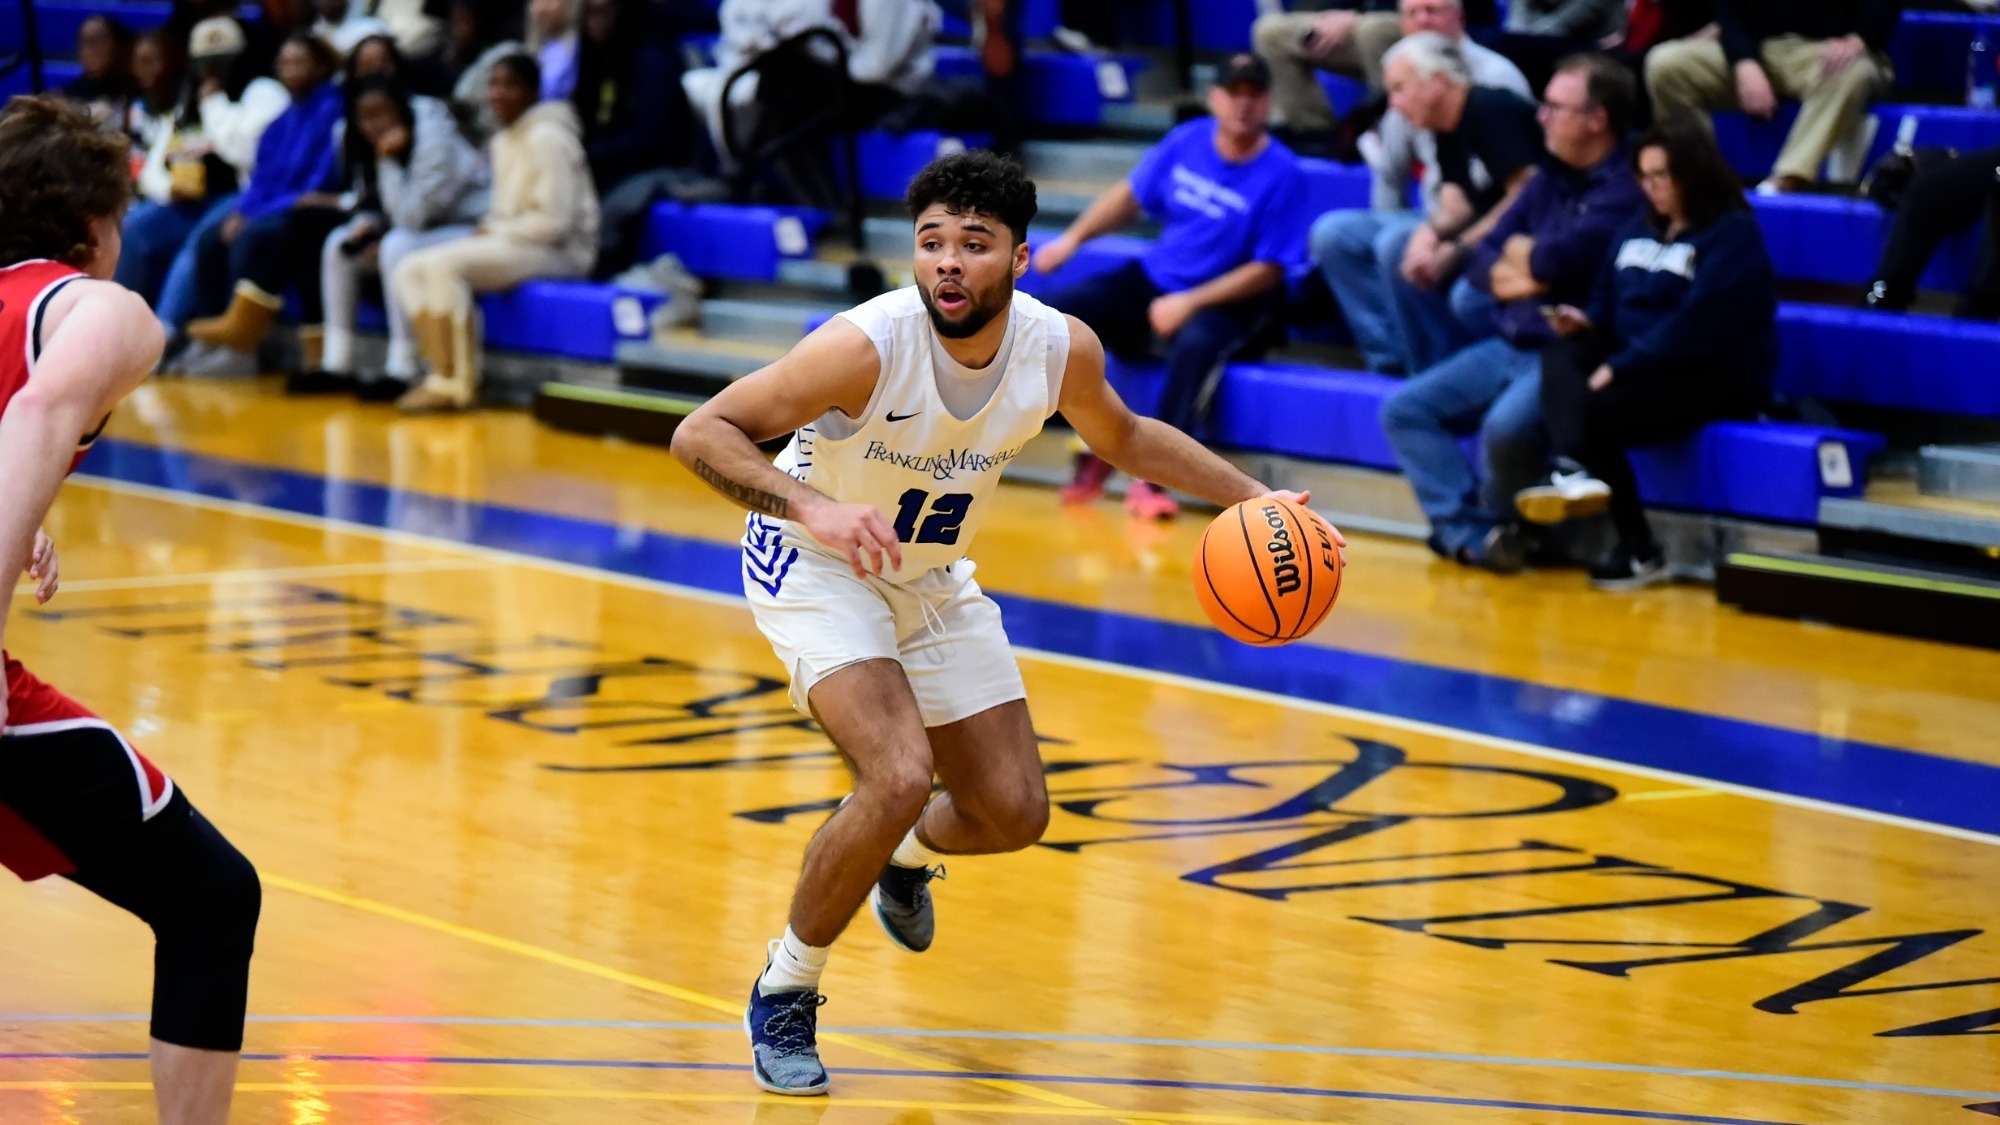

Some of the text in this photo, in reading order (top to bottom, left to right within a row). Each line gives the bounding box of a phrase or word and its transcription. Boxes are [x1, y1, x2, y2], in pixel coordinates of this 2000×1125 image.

[864, 440, 942, 472] FRANKLIN
[893, 488, 974, 545] 12
[1261, 505, 1302, 597] Wilson
